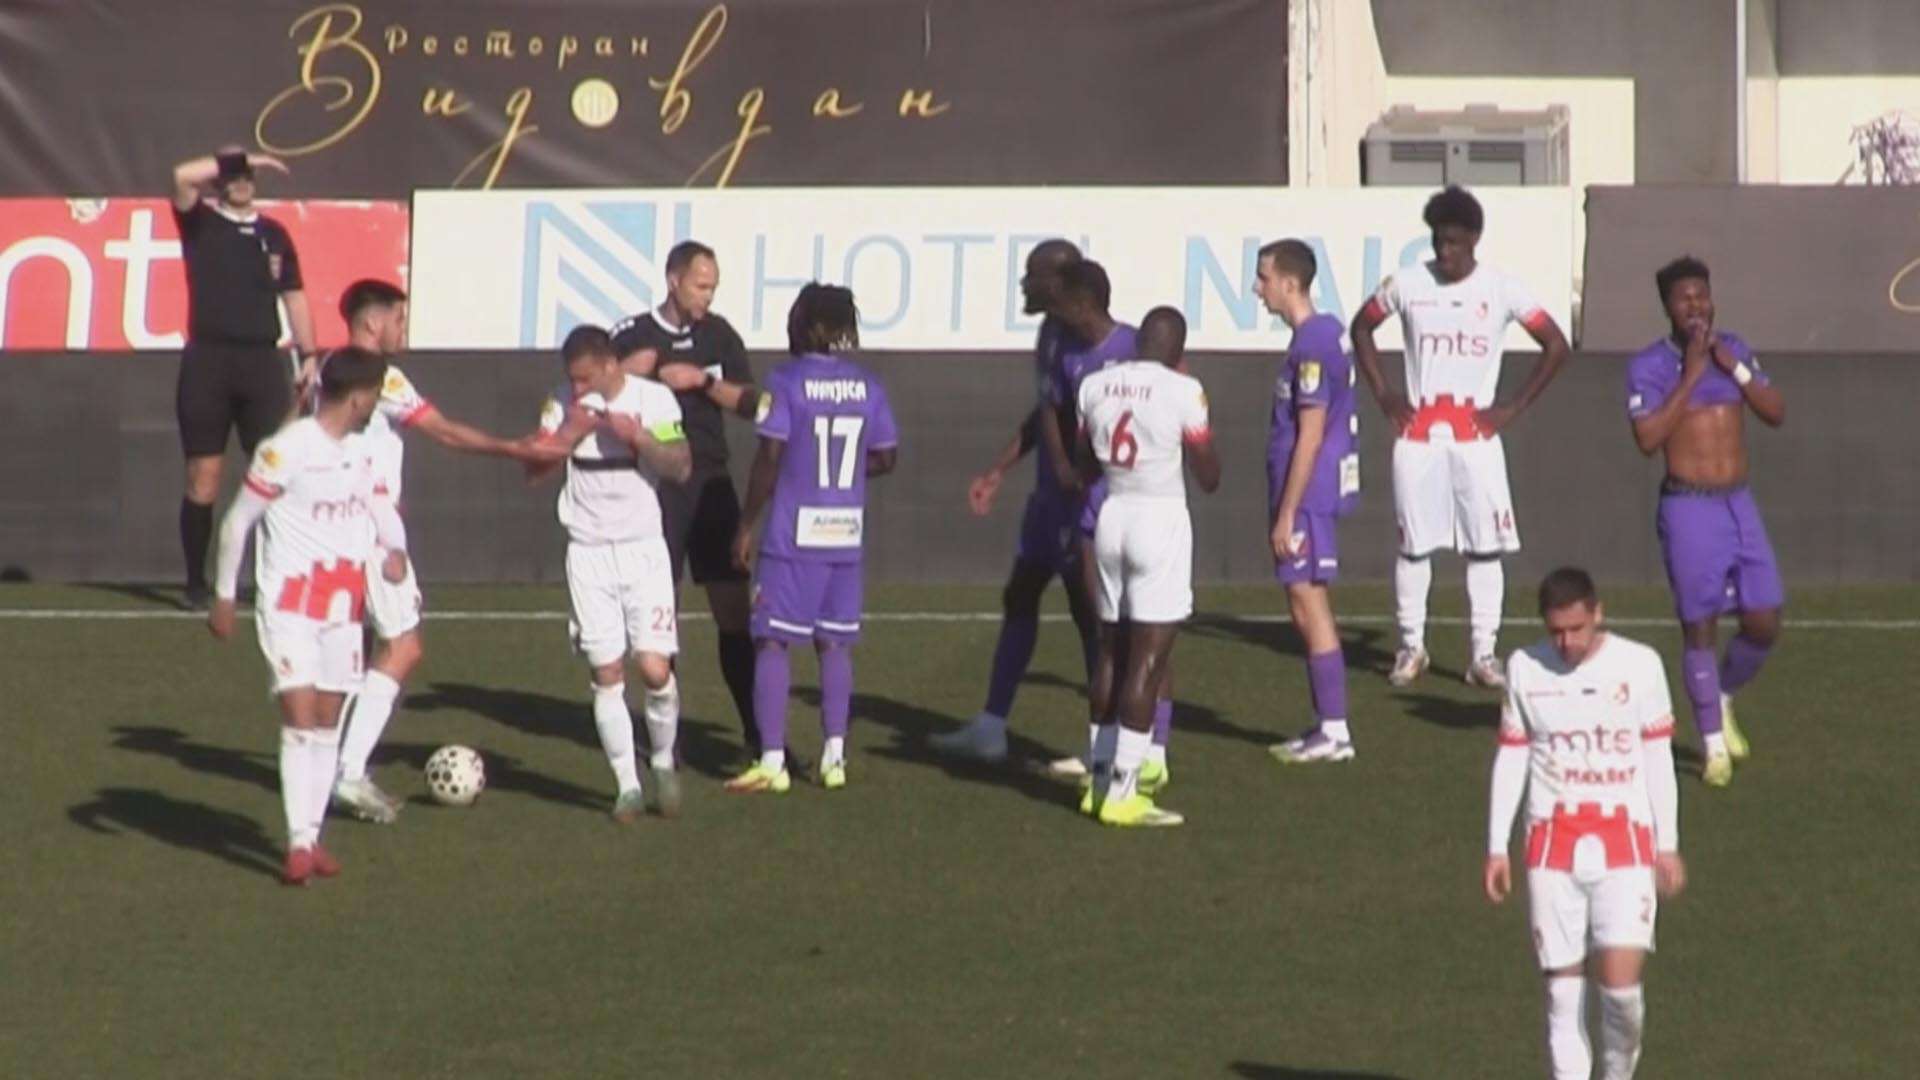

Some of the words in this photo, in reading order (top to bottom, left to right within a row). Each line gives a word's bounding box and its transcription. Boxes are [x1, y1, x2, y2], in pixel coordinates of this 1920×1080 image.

[384, 26, 649, 69] Ресторан
[752, 233, 1089, 331] HOTE
[1419, 331, 1488, 357] mts
[814, 416, 864, 489] 17
[1110, 409, 1138, 470] 6
[1493, 509, 1511, 532] 14
[1549, 725, 1633, 754] mts
